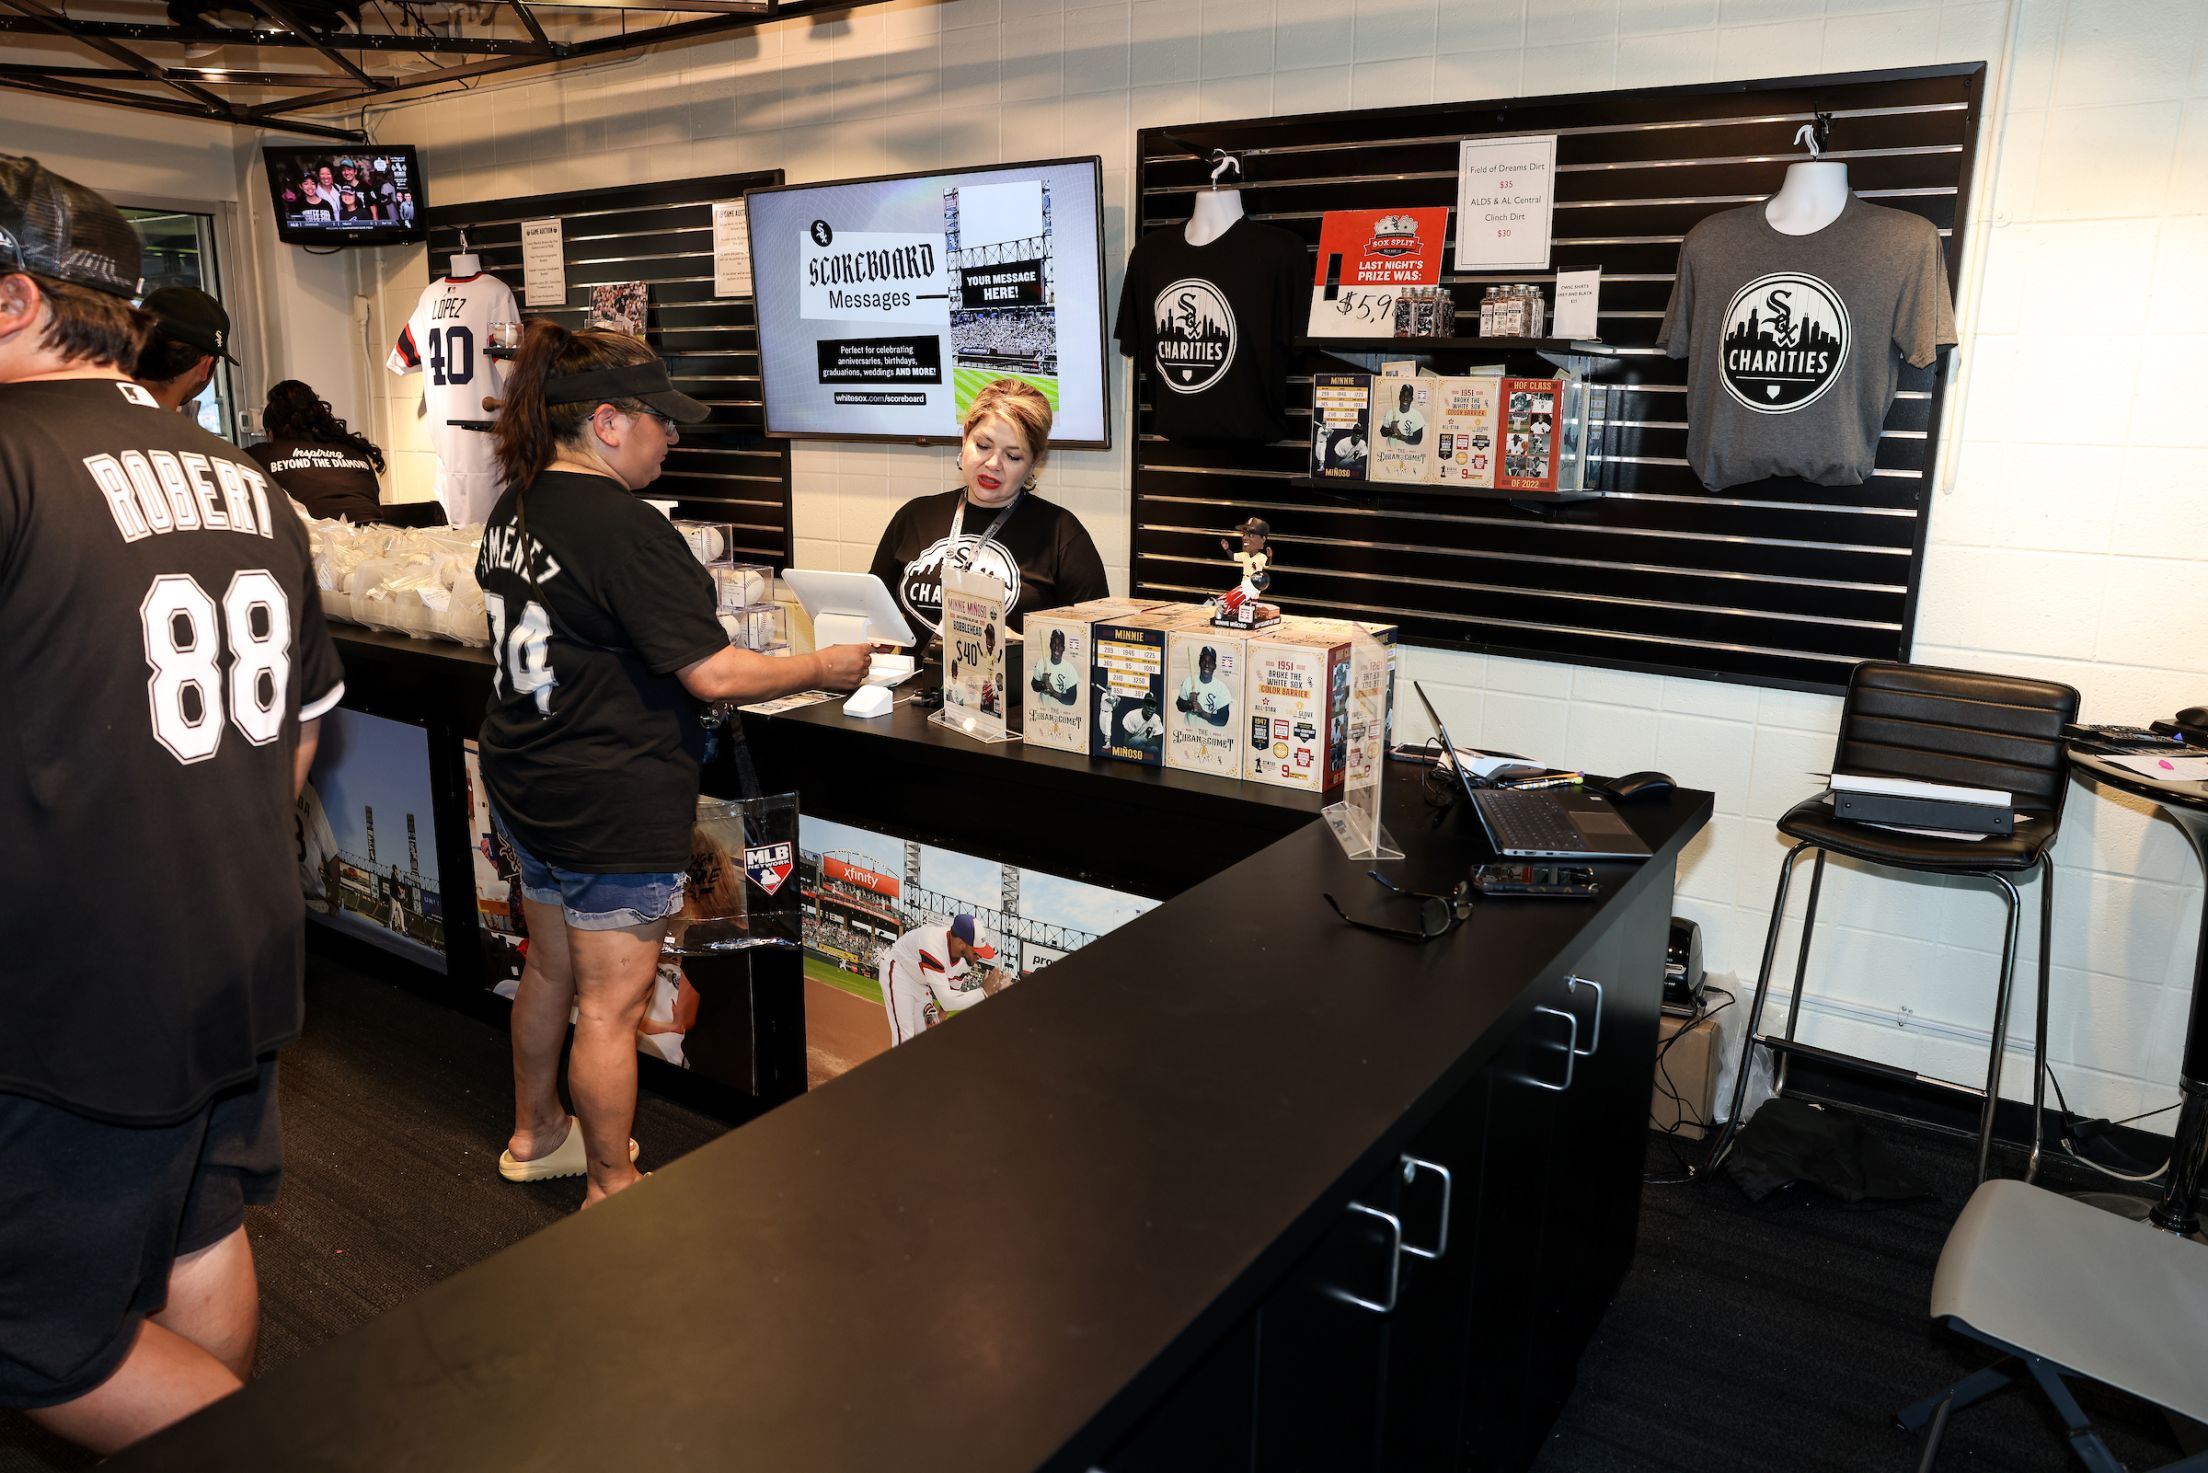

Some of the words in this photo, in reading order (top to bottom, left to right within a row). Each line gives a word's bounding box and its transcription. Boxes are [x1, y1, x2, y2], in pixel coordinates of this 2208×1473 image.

[1470, 165, 1488, 174] Field
[1488, 164, 1497, 173] of
[1498, 163, 1527, 173] Dreams
[1529, 162, 1545, 171] Dirt
[1500, 180, 1513, 189] $35
[1470, 197, 1492, 206] ALDS
[1493, 197, 1499, 205] &
[1500, 197, 1513, 205] AL
[1514, 195, 1541, 204] Central
[1485, 213, 1507, 222] Clinch
[1510, 212, 1525, 221] Dirt
[1497, 229, 1511, 238] $30
[1372, 239, 1390, 248] SOX
[1391, 239, 1414, 247] SPLIT
[809, 243, 935, 288] SCOREBOARD
[1359, 261, 1384, 270] LAST
[1384, 260, 1423, 270] NIGHT'S
[966, 274, 991, 286] YOUR
[992, 271, 1036, 284] MESSAGE
[1357, 271, 1388, 281] PRIZE
[1388, 271, 1421, 281] WAS:
[984, 286, 1019, 301] HERE!
[829, 290, 911, 311] Messages
[840, 345, 864, 354] Perfect
[865, 345, 876, 354] for
[876, 344, 913, 355] celebrating
[1158, 341, 1222, 361] CHARITIES
[429, 326, 474, 386] 40
[838, 357, 882, 366] anniversaries,
[884, 356, 918, 367] birthdays,
[1729, 350, 1829, 374] CHARITIES
[823, 367, 862, 377] graduations,
[863, 367, 894, 377] weddings
[895, 367, 911, 376] AND
[911, 367, 937, 376] MORE!
[1331, 377, 1355, 385] MINNIE
[1514, 381, 1528, 390] HOF
[1529, 381, 1551, 390] CLASS
[1461, 389, 1474, 397] 1951
[836, 394, 924, 404] whitesox.com/scoreboard
[292, 447, 344, 460] Inspiring
[270, 458, 310, 473] BEYOND
[313, 458, 331, 468] THE
[333, 458, 370, 471] DIAMOND
[1461, 468, 1468, 479] 9
[1511, 479, 1521, 488] OF
[1521, 480, 1539, 488] 2022
[83, 449, 274, 544] ROBERT
[948, 597, 966, 614] MINNIE
[953, 620, 982, 637] BOBBLEHEAD
[1114, 629, 1144, 642] MINNIE
[956, 639, 978, 667] $40
[139, 569, 292, 766] 88
[1277, 661, 1294, 671] 1951
[1268, 670, 1288, 680] BROKE
[1290, 672, 1301, 681] THE
[1267, 678, 1287, 688] WHITE
[1290, 680, 1303, 689] SOX
[1260, 685, 1281, 695] COLOR
[1282, 689, 1308, 698] BARRIER
[1255, 704, 1276, 712] ALL-STAR
[1112, 745, 1143, 760] MIÑOSO
[1282, 764, 1290, 778] 9
[747, 845, 789, 865] MLB
[748, 859, 790, 870] NETWORK
[844, 867, 878, 889] xfinity
